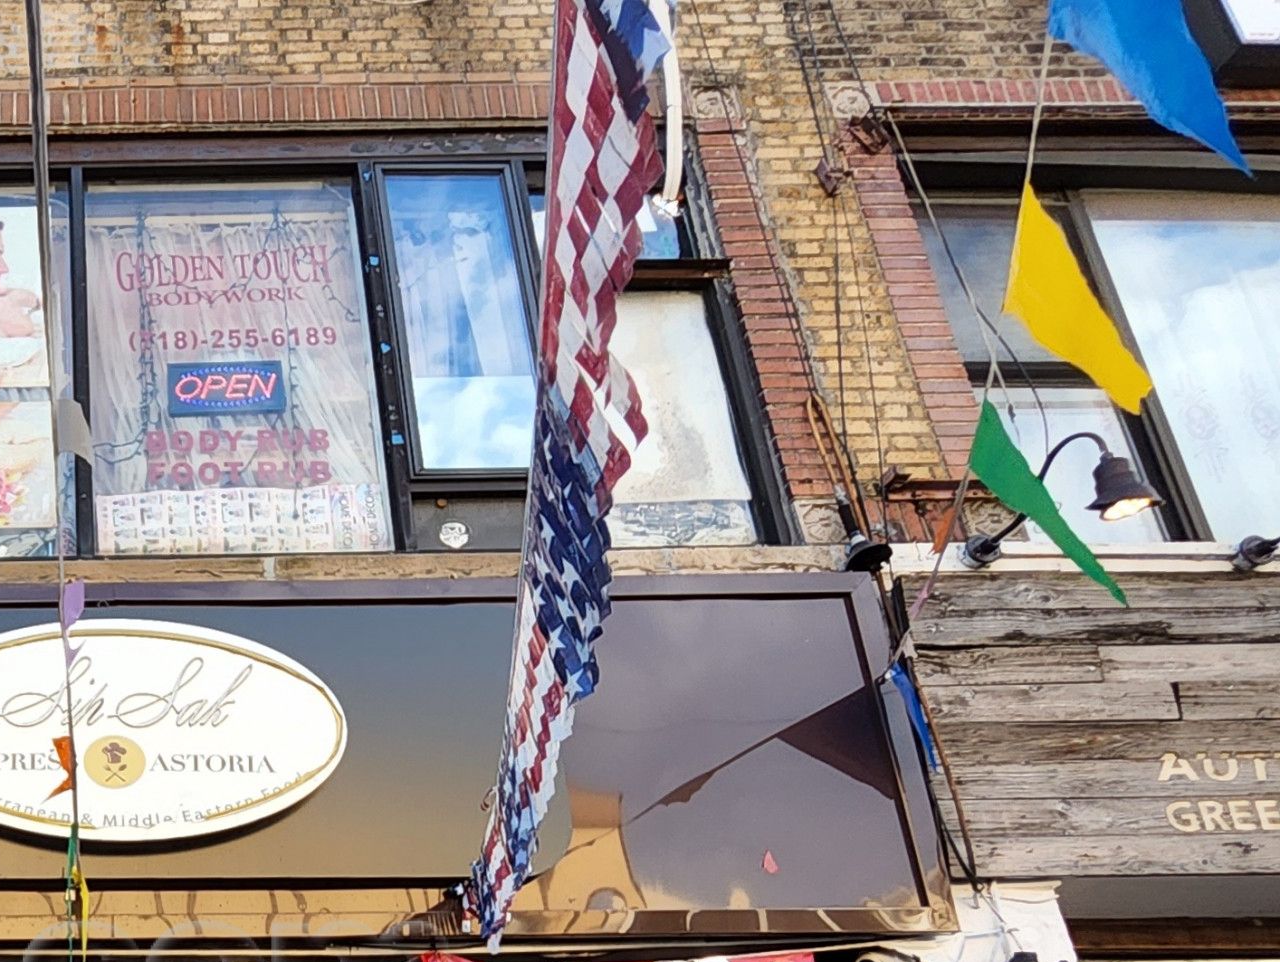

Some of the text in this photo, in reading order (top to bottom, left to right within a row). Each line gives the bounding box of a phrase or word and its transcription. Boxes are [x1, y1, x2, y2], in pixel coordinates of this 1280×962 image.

[115, 245, 333, 292] GOLDEN TOUCH
[148, 286, 304, 307] BODYWORK
[175, 373, 278, 400] OPEN
[146, 429, 330, 453] BODY RUB
[148, 461, 333, 485] FOOT RUB
[108, 656, 254, 728] Sak
[149, 753, 277, 774] ASTORIA
